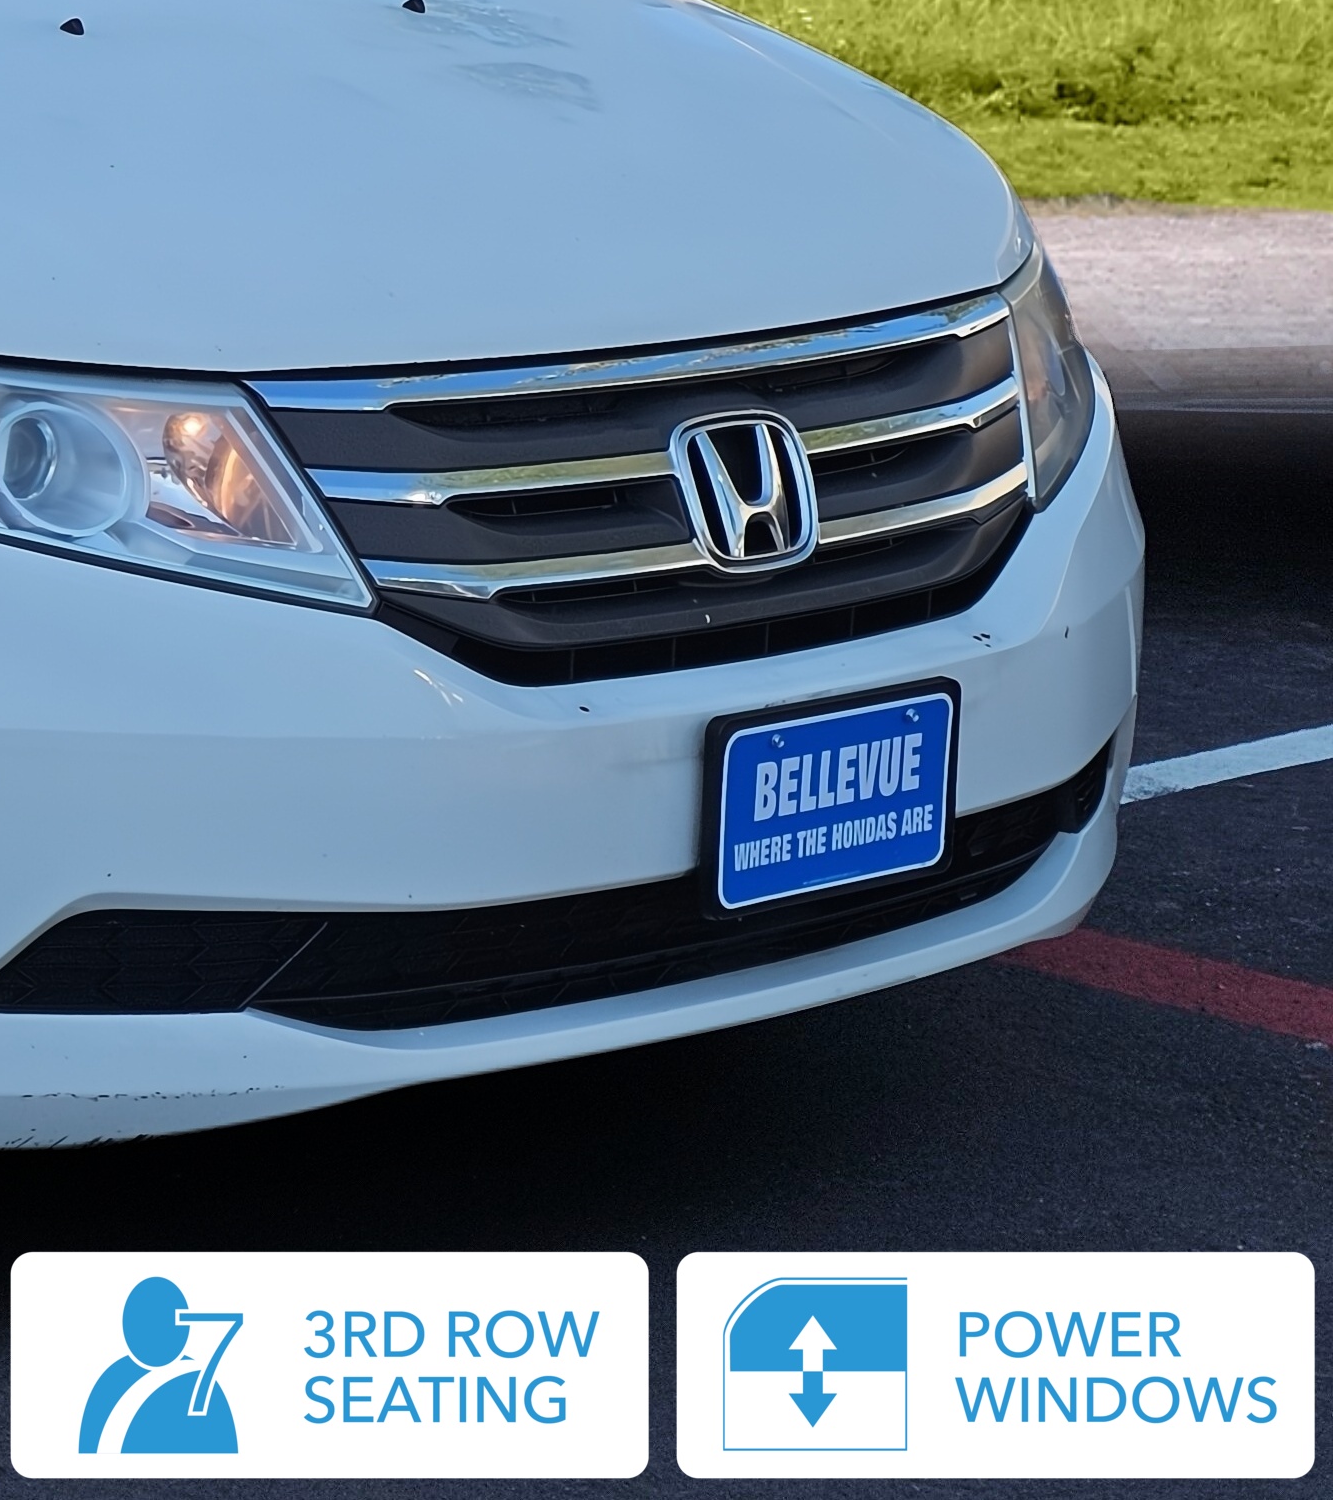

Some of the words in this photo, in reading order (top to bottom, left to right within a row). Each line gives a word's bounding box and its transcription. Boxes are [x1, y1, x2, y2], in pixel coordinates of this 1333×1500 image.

[753, 732, 923, 822] BELLEVUE
[734, 833, 792, 872] WHERE
[796, 825, 827, 859] THE
[831, 811, 897, 851] HONDAS
[900, 804, 933, 836] ARE
